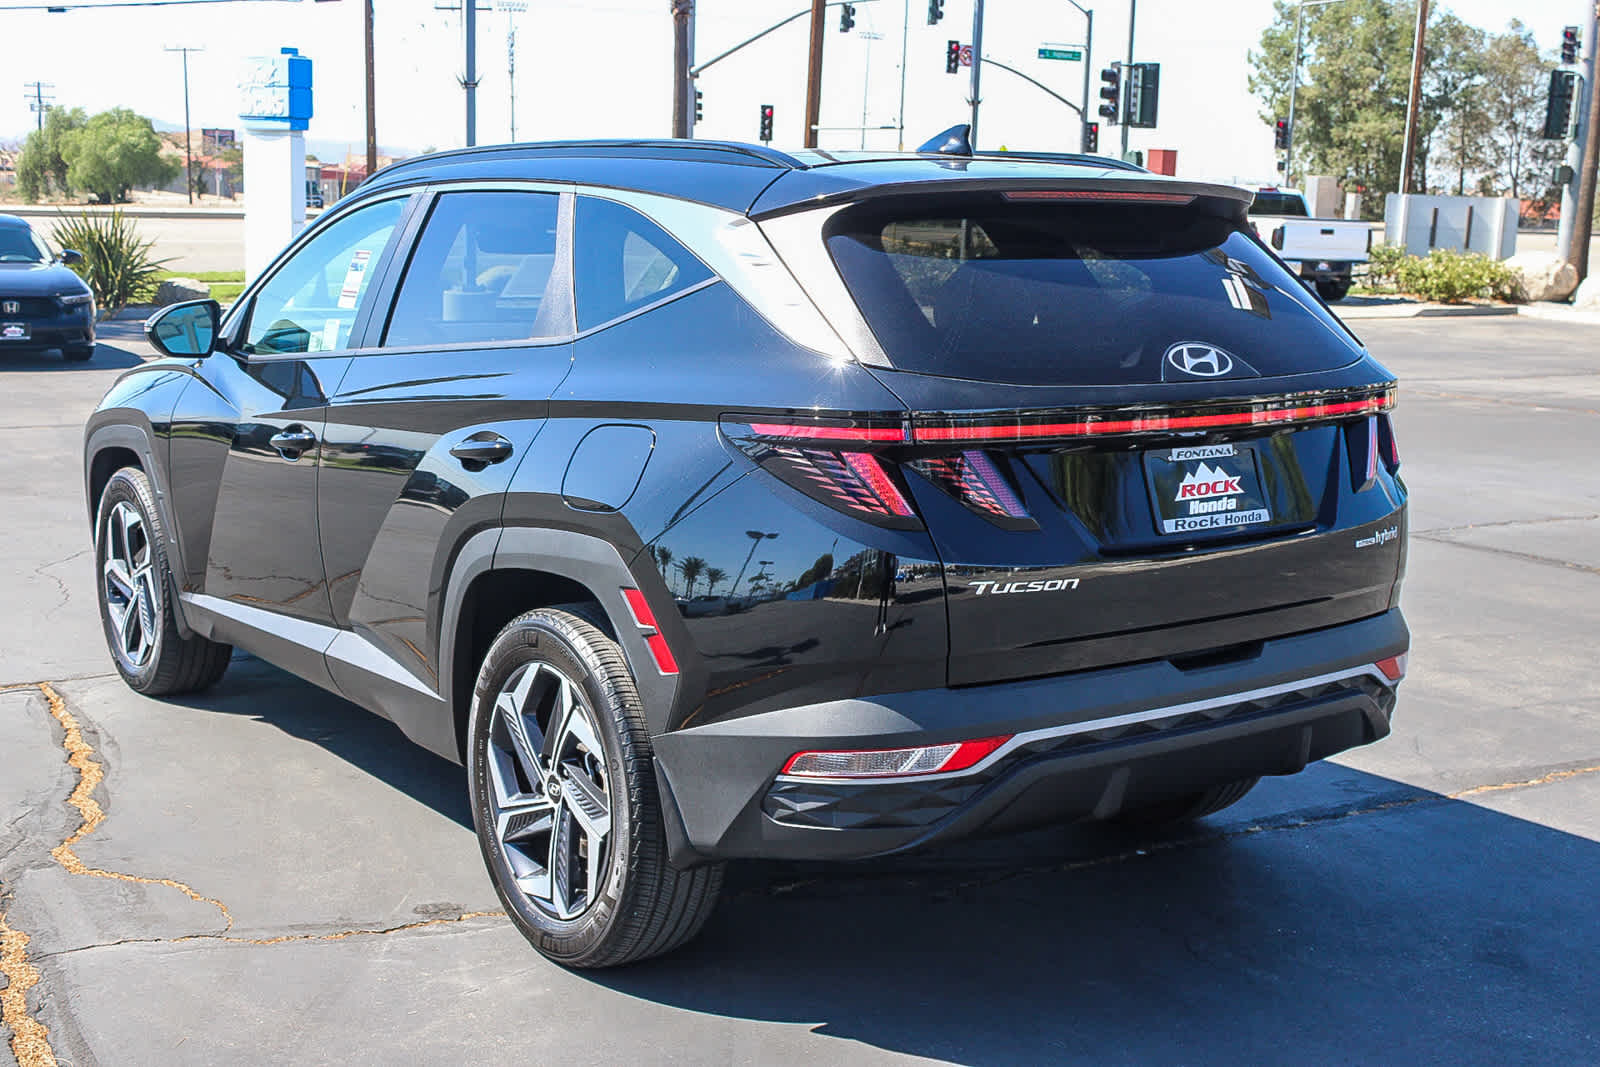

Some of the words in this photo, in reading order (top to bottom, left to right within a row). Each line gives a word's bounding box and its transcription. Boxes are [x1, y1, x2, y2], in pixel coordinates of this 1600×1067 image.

[1176, 447, 1232, 459] FONTANA
[1181, 479, 1239, 498] ROCK
[1189, 497, 1237, 515] Honda
[1174, 517, 1220, 531] Rock
[1224, 512, 1262, 525] Honda
